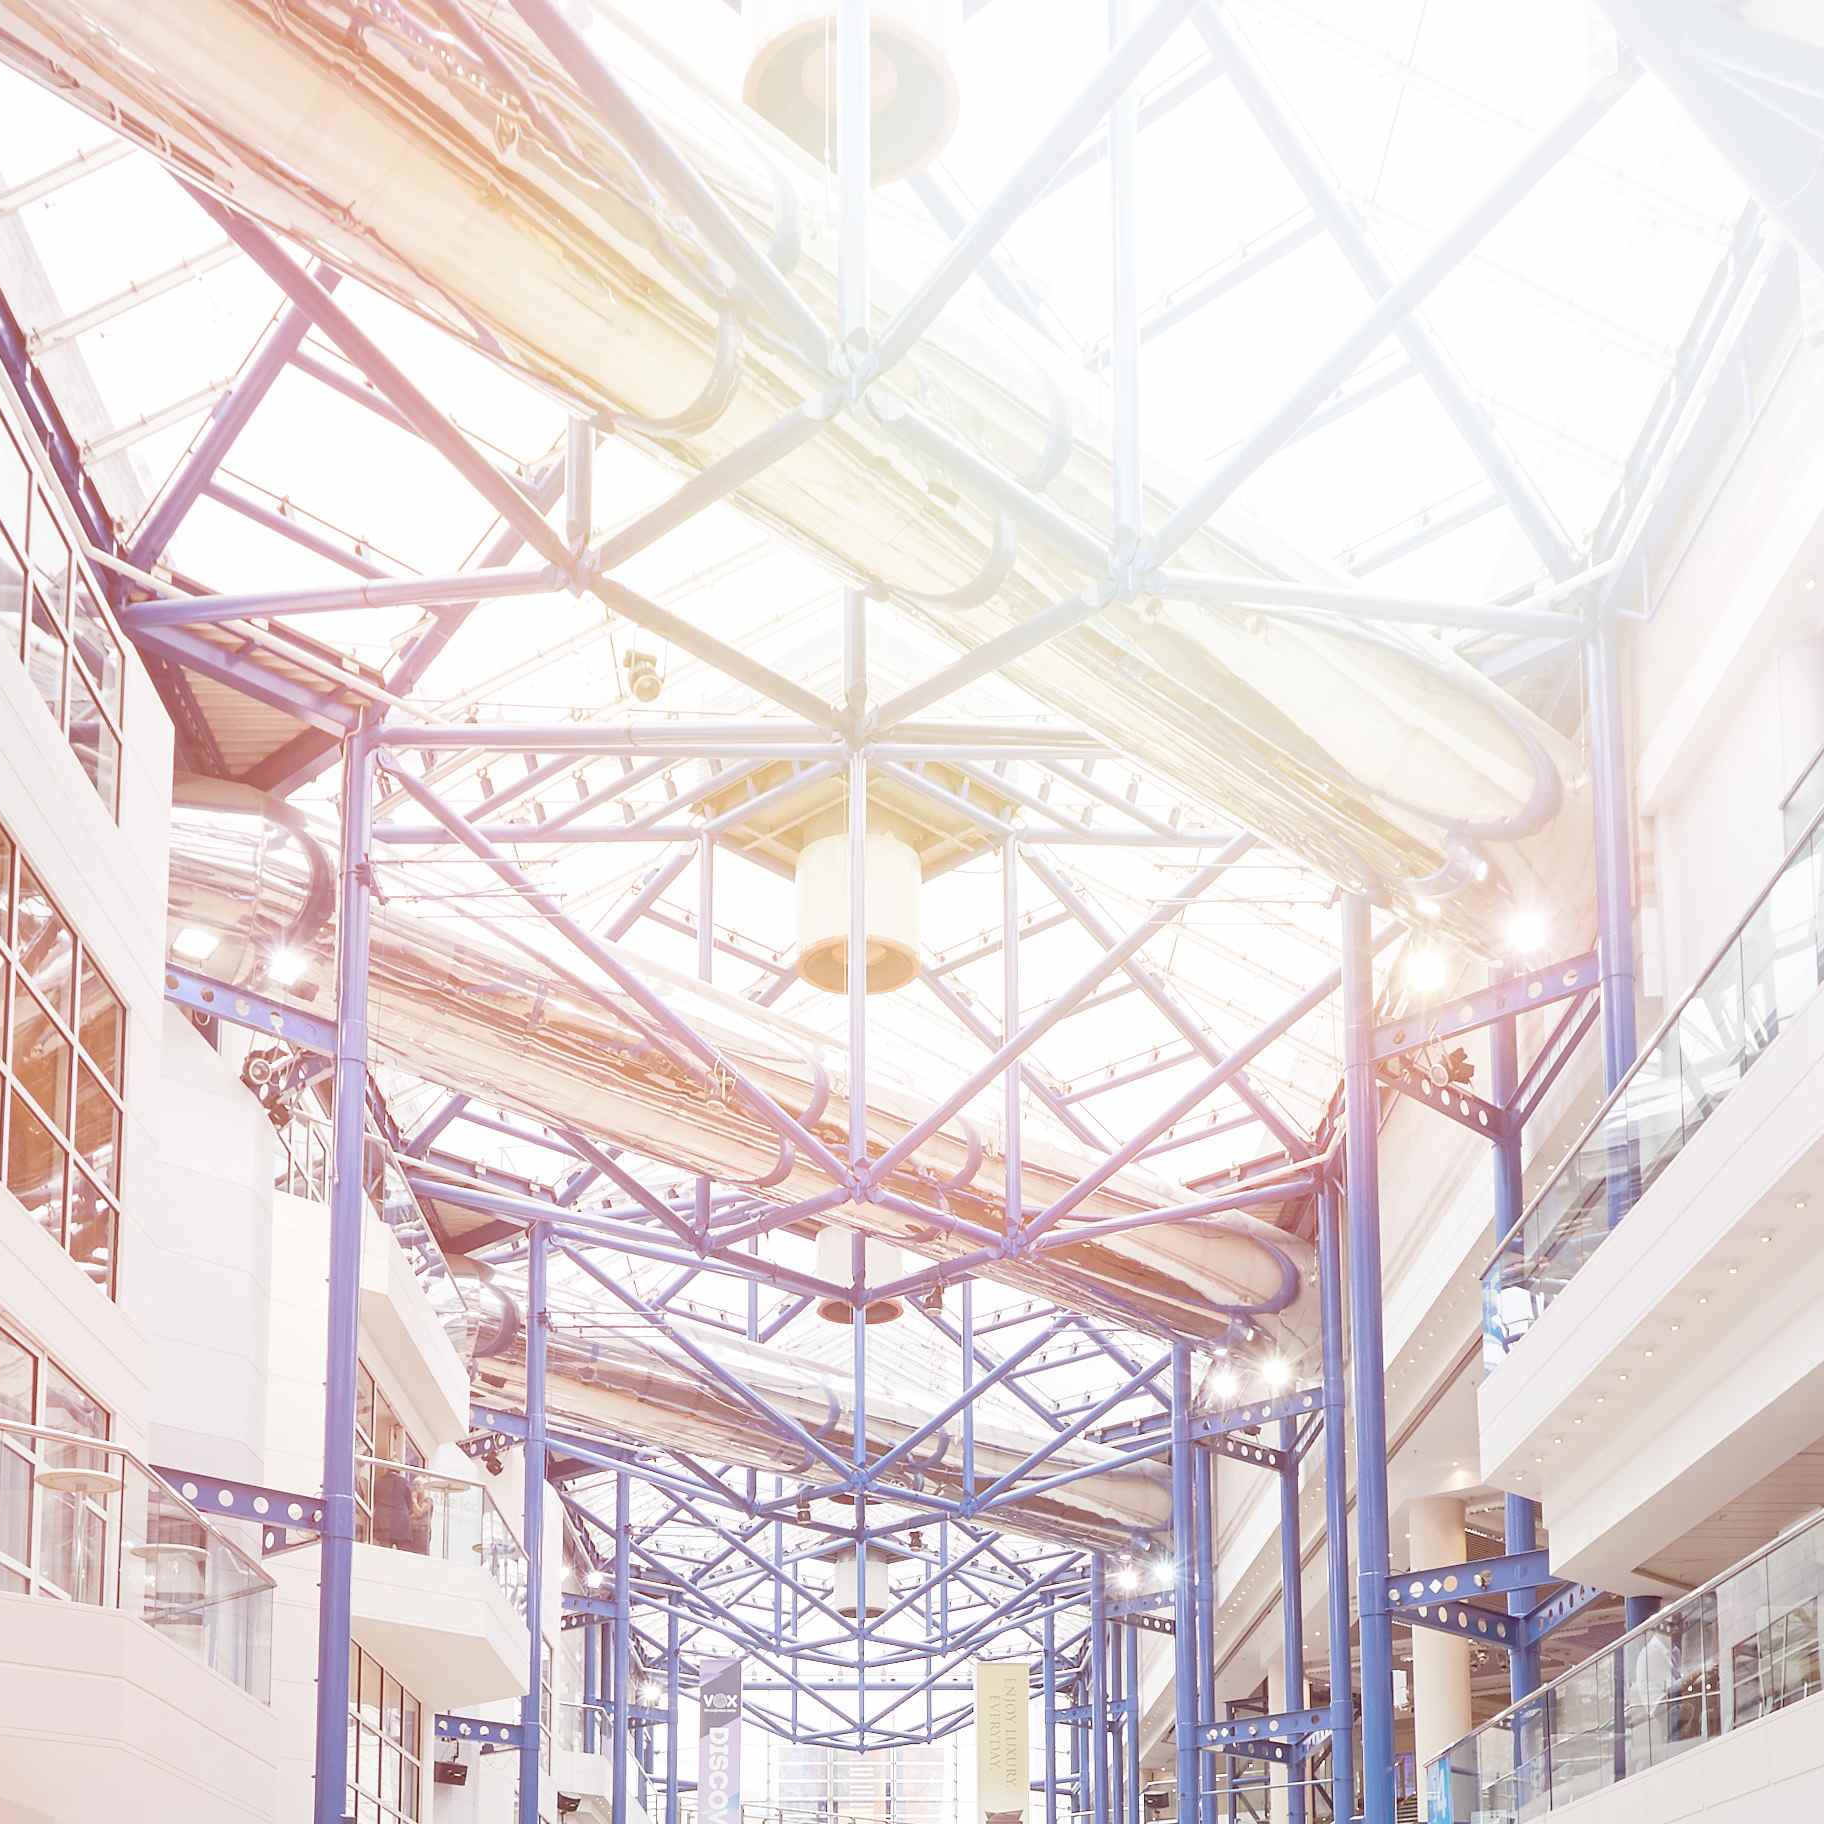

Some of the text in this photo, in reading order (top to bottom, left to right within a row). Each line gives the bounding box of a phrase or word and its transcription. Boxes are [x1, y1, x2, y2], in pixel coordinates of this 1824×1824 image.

[703, 1692, 738, 1709] VOX
[1003, 1678, 1017, 1787] ENJOY LUXURY
